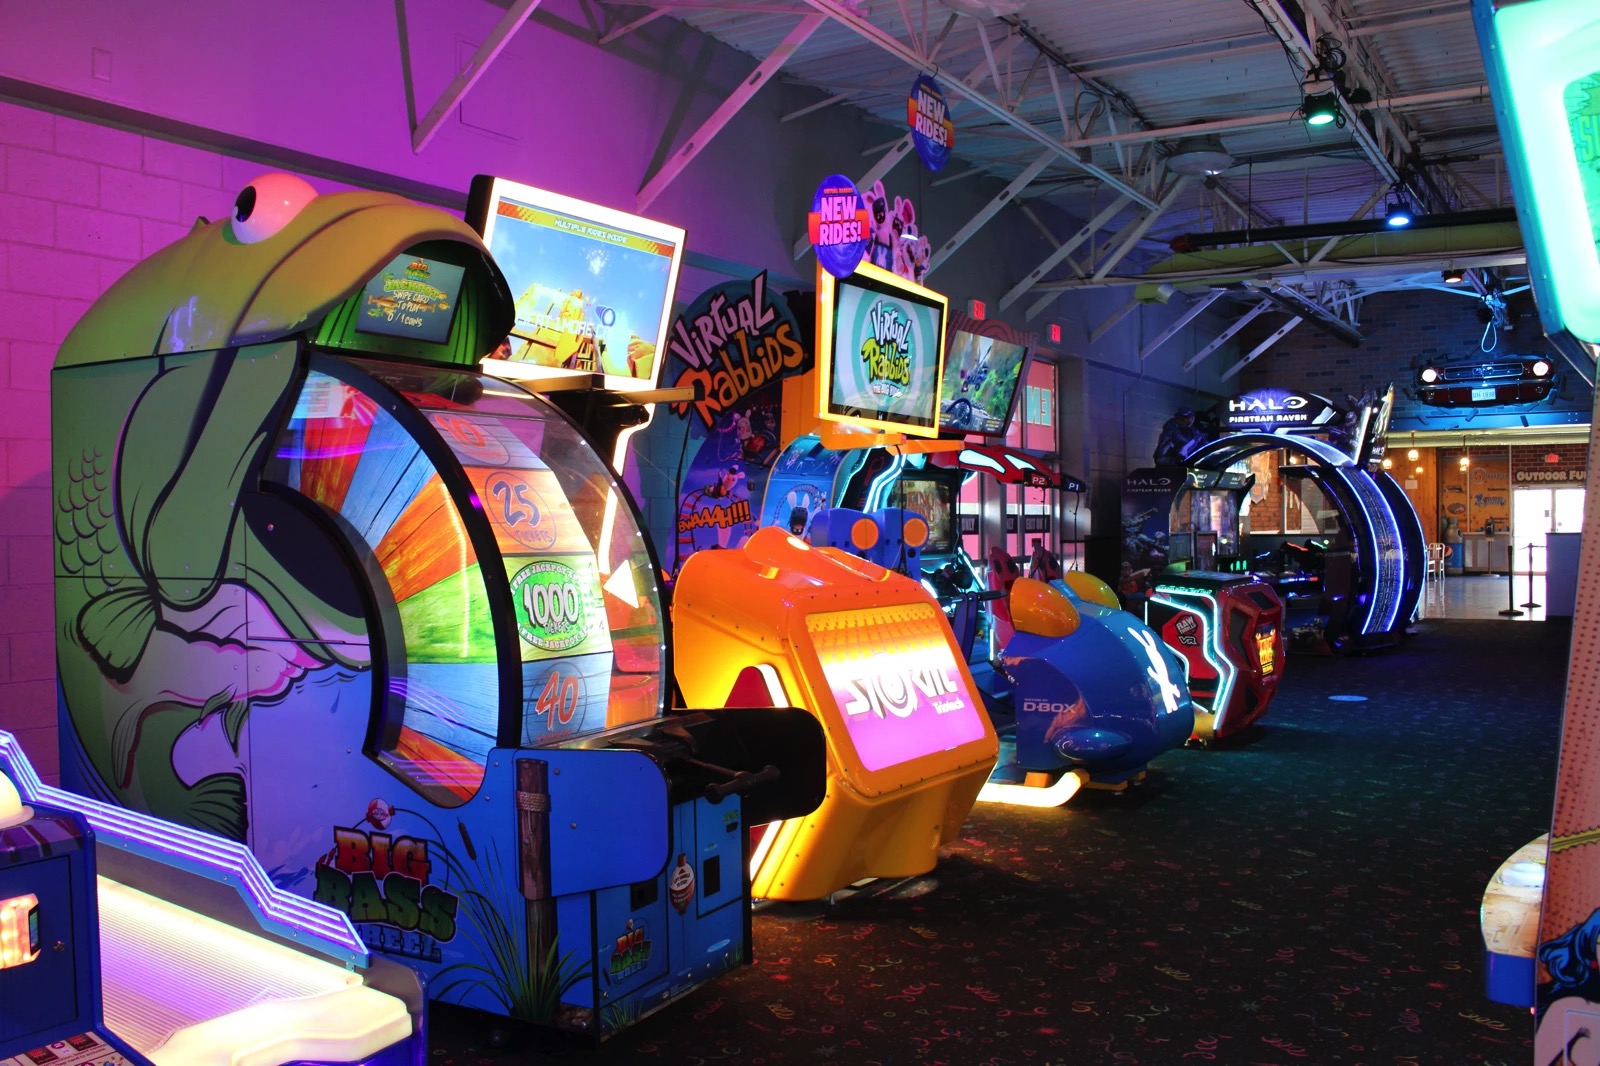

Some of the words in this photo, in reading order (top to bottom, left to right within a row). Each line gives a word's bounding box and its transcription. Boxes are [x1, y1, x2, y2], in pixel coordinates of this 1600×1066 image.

[917, 89, 945, 124] NEW
[915, 112, 948, 148] RIDES!
[821, 195, 858, 222] NEW
[554, 219, 586, 233] MULTIPLE
[819, 221, 862, 246] RIDES!
[393, 290, 412, 301] SWIPE
[412, 292, 430, 303] CARD
[1229, 396, 1308, 412] HALO
[1229, 415, 1273, 423] FIRETEAM
[1032, 476, 1044, 485] P2
[1127, 477, 1171, 486] HALO
[1516, 471, 1567, 481] OUTDOOR
[1068, 482, 1080, 490] P1
[491, 480, 541, 528] 25
[514, 529, 553, 544] TICKETS
[532, 563, 569, 577] JACKPOT
[523, 582, 580, 628] 1000
[543, 622, 571, 636] TICKETS
[1176, 616, 1195, 630] RAW
[521, 629, 543, 647] FREE
[544, 635, 580, 649] JACKPOT
[1177, 635, 1198, 646] VR
[535, 671, 579, 731] 40
[334, 826, 432, 886] BIG
[313, 863, 459, 943] BASS
[360, 924, 442, 963] HEEL
[617, 926, 645, 954] BIG
